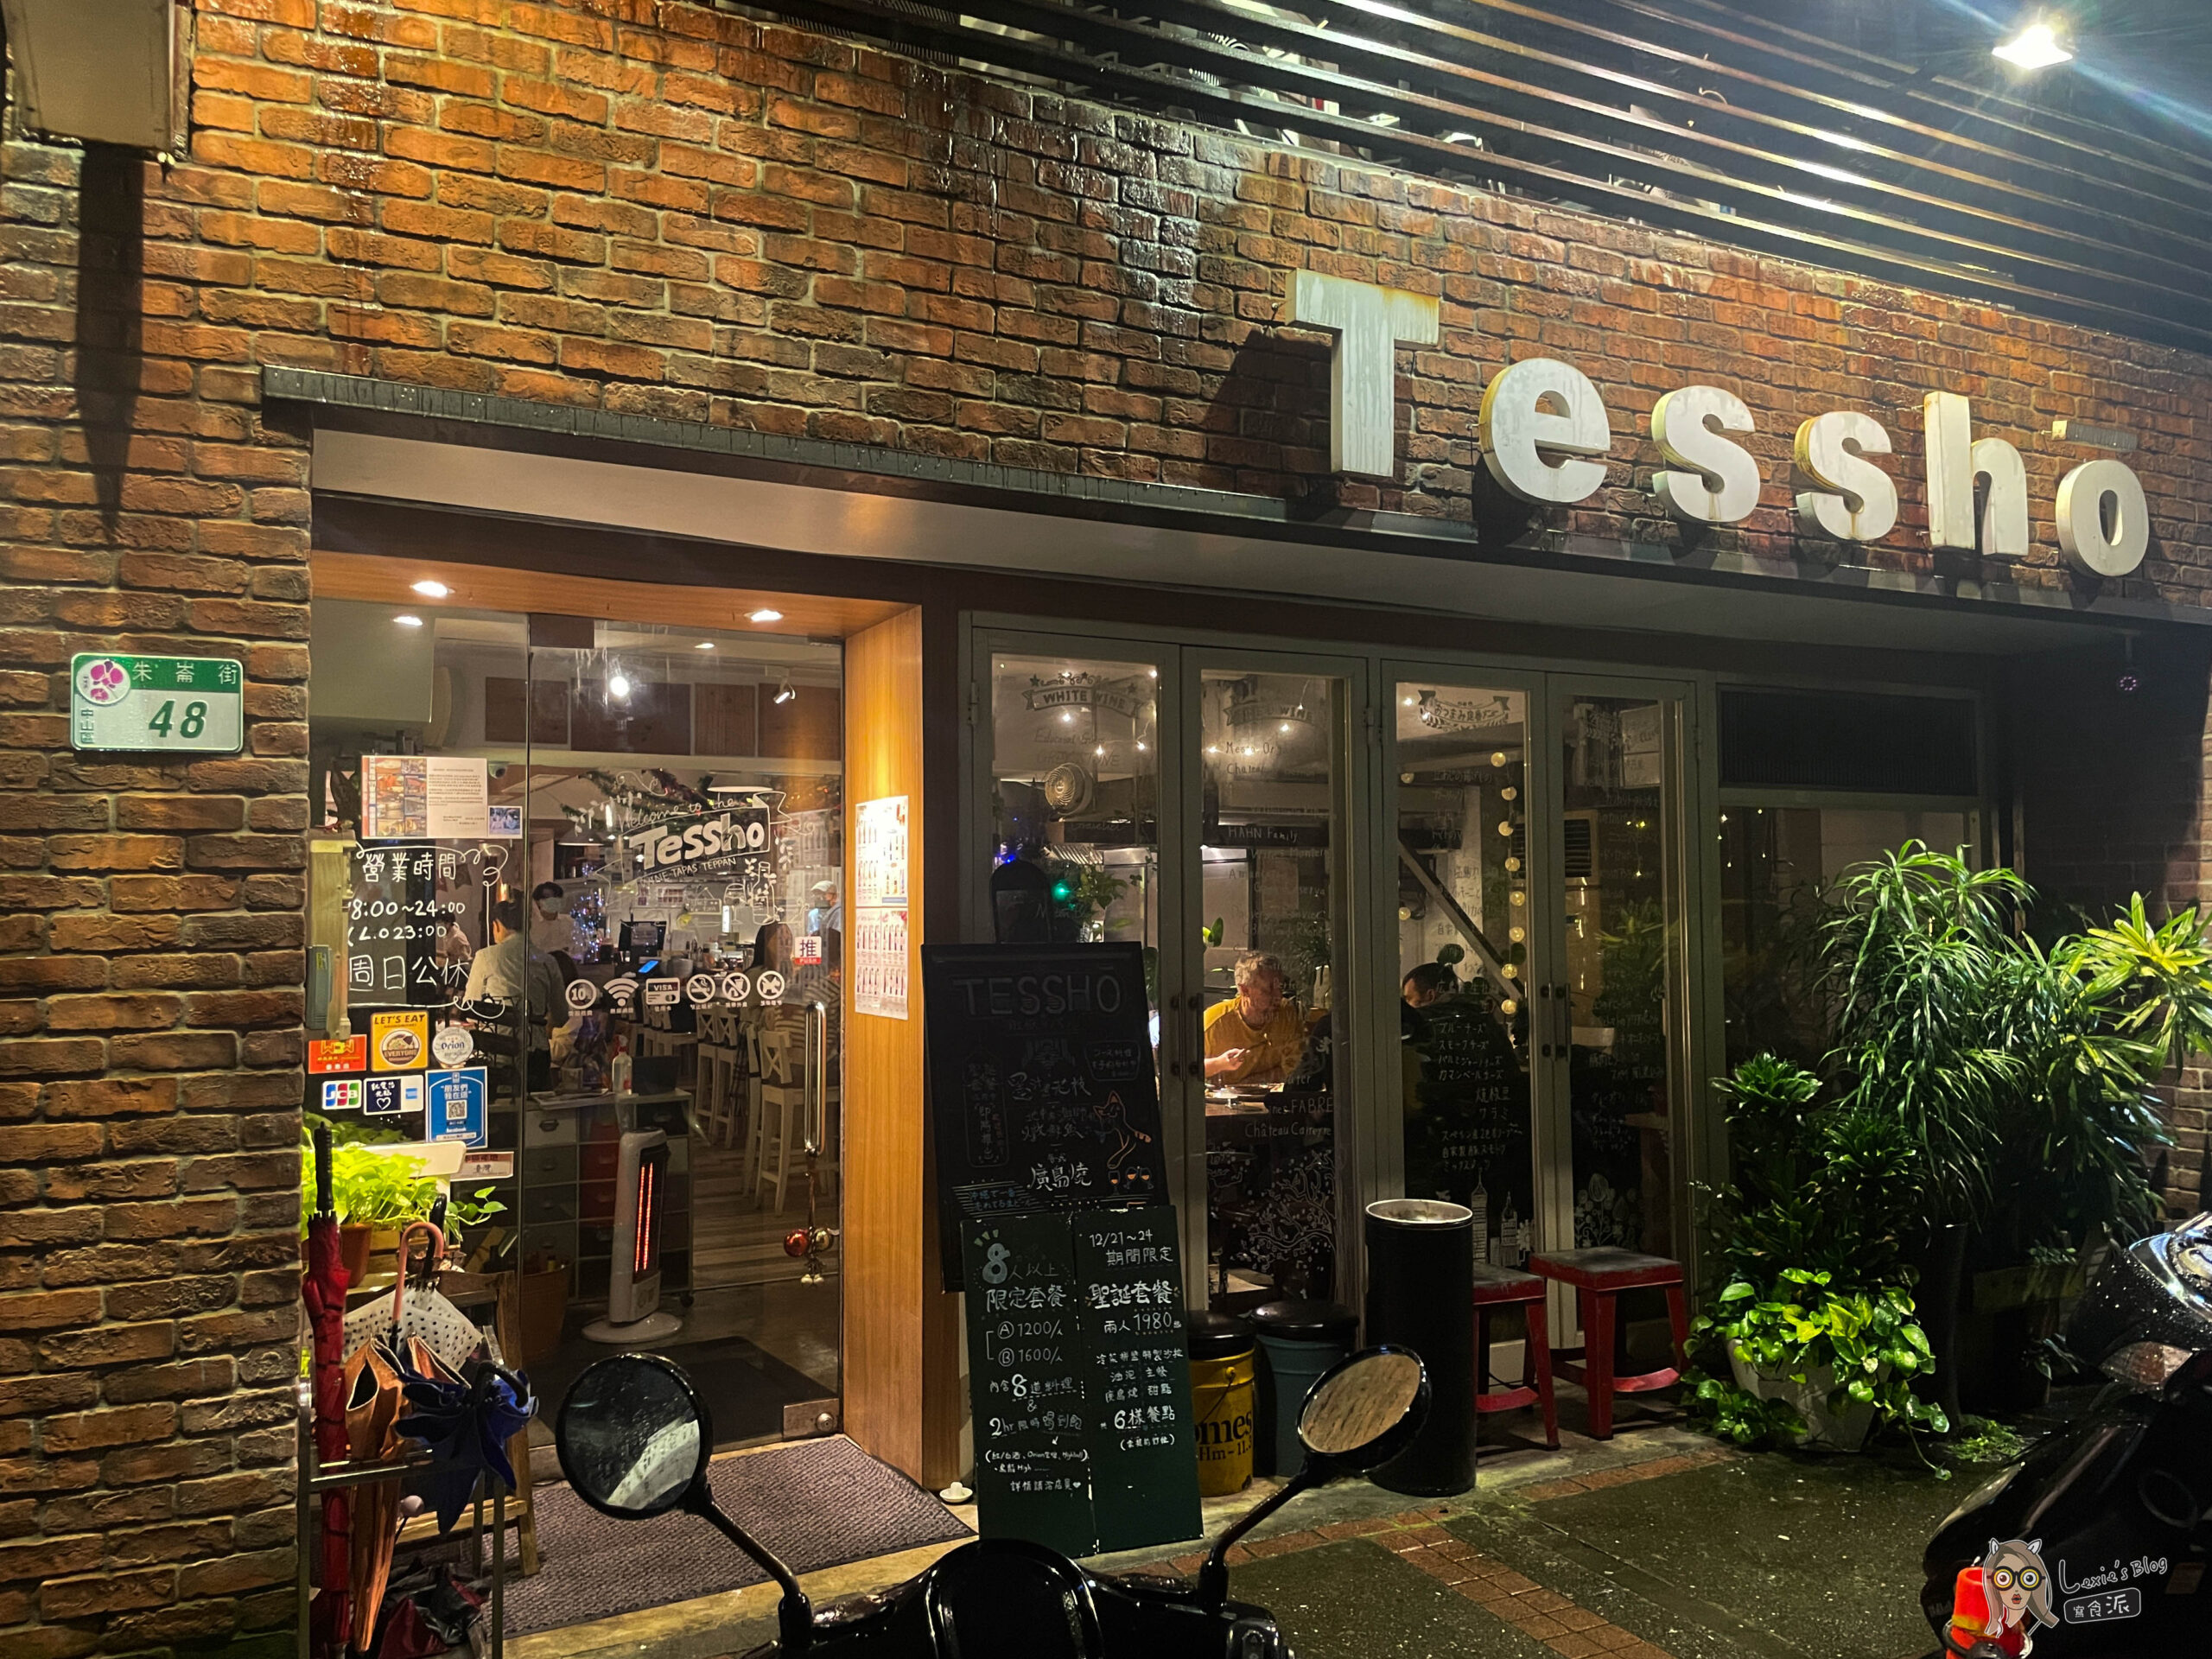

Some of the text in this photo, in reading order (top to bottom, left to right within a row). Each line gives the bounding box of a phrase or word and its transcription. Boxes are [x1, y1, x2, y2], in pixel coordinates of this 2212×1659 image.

[131, 660, 238, 685] 朱崙街
[1043, 690, 1088, 704] WHITE
[148, 698, 209, 739] 48
[618, 791, 736, 832] Welcome to the
[628, 811, 766, 870] Tessho
[1228, 825, 1262, 839] HAHN
[362, 850, 457, 883] 營業時間
[671, 863, 699, 879] TAPAS
[701, 856, 738, 872] TEPPAN
[393, 925, 447, 940] 23:00
[800, 938, 817, 957] 推
[373, 1014, 427, 1026] LET'S EAT
[441, 1040, 465, 1050] Orion
[325, 1082, 359, 1107] JCB
[1291, 1096, 1334, 1114] FABRE
[1089, 1229, 1154, 1248] 12/21~24
[982, 1242, 1060, 1285] 8人以上
[1106, 1246, 1174, 1267] 期間限定
[986, 1283, 1068, 1313] 限定套餐
[1088, 1279, 1175, 1311] 聖誕套餐
[1027, 1398, 1038, 1413] &
